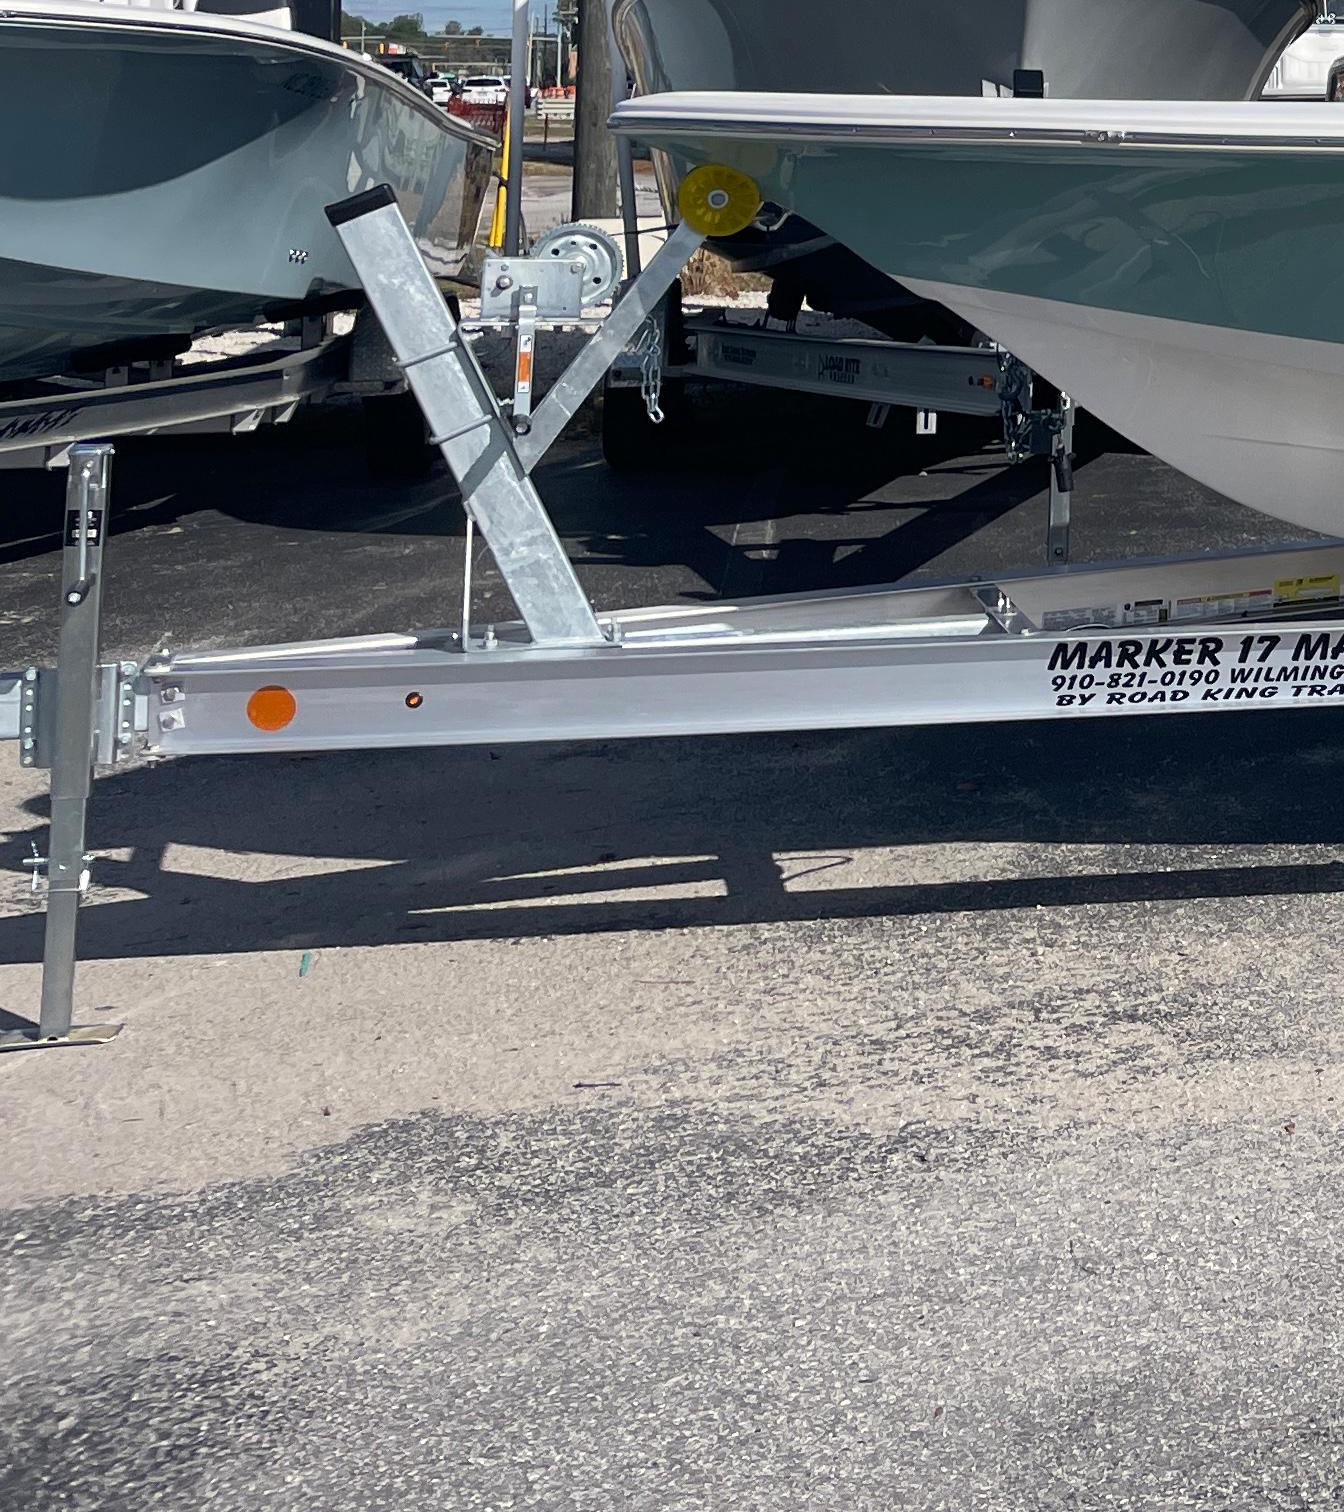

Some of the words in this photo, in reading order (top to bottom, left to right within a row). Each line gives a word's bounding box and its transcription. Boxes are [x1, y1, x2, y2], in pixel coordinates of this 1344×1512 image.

[1047, 636, 1223, 670] MARKER
[1237, 635, 1281, 664] 17
[1051, 669, 1220, 692] 910-821-0190
[1056, 693, 1096, 706] BY
[1105, 689, 1190, 705] ROAD
[1201, 686, 1279, 702] KING
